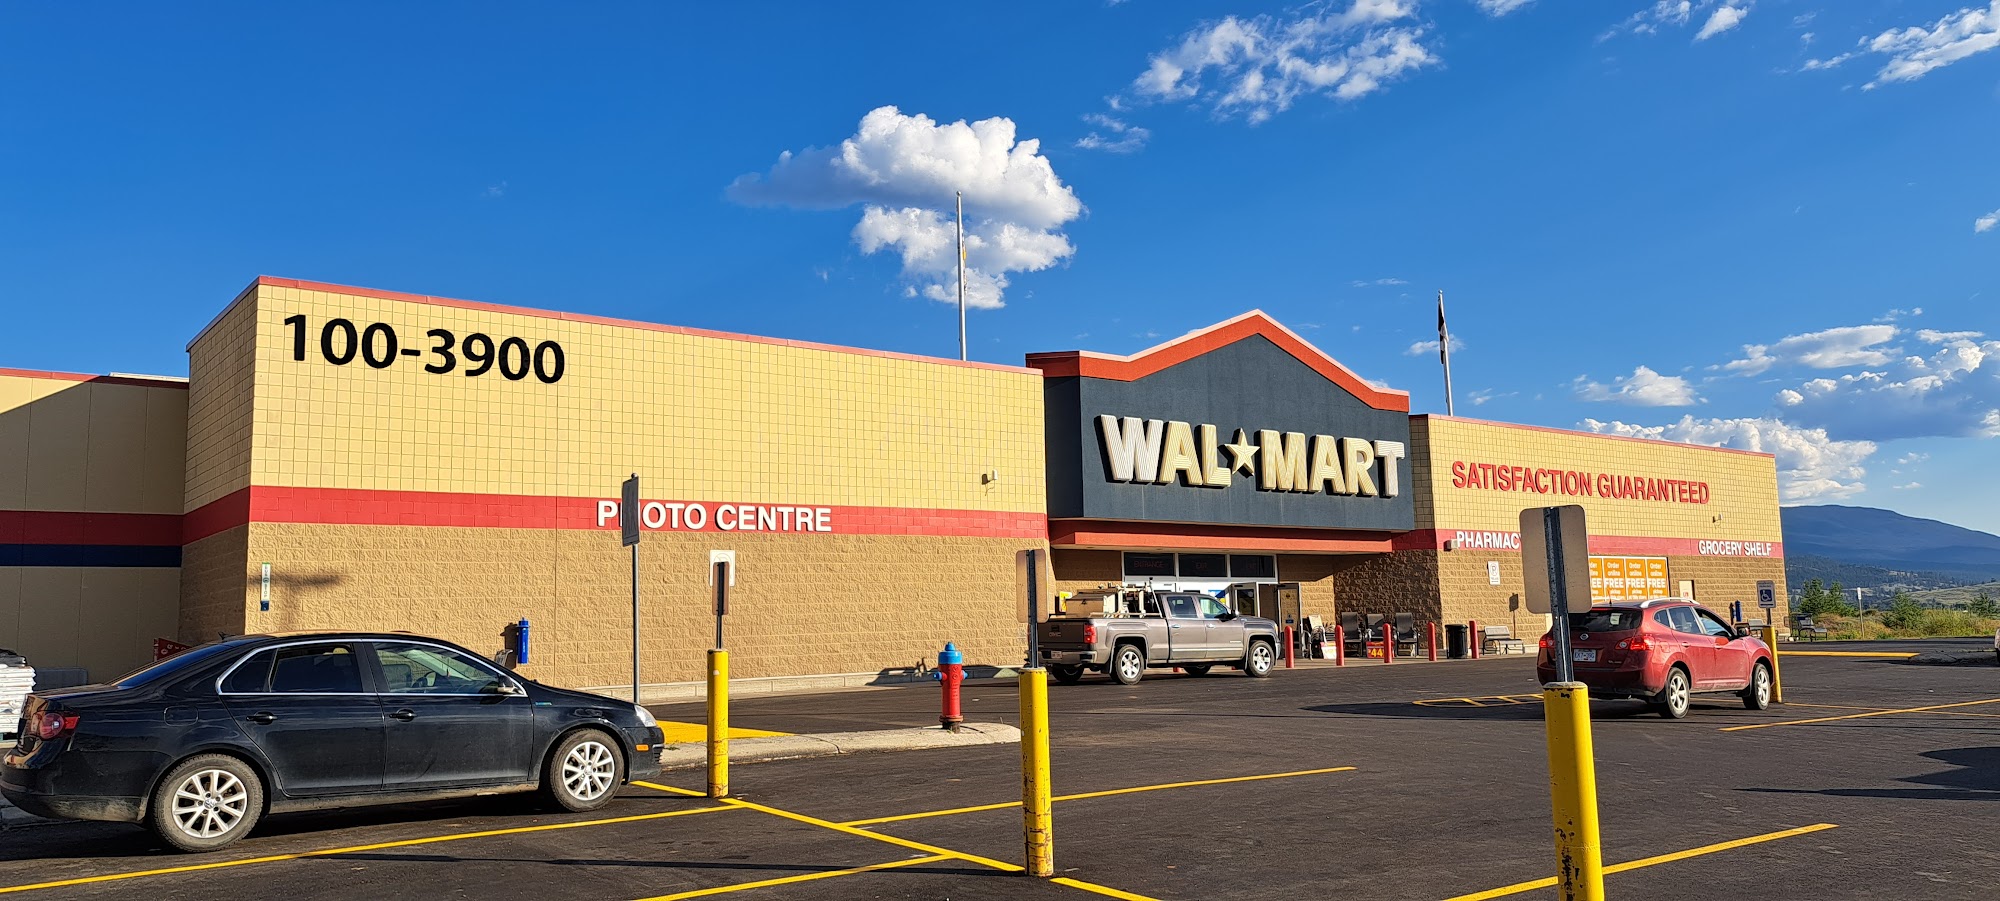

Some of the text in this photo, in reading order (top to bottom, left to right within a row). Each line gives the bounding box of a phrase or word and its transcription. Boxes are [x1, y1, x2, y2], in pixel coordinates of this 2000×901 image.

[284, 314, 565, 384] 100-3900
[1452, 461, 1709, 505] SATISFACTION GUARANTEED
[597, 500, 831, 532] POTO CENTRE
[1456, 531, 1522, 549] PHARMAC
[1698, 540, 1772, 556] GROCERY SHELF
[1604, 578, 1624, 588] FREE
[1626, 578, 1646, 588] FREE
[1647, 578, 1666, 588] FREE
